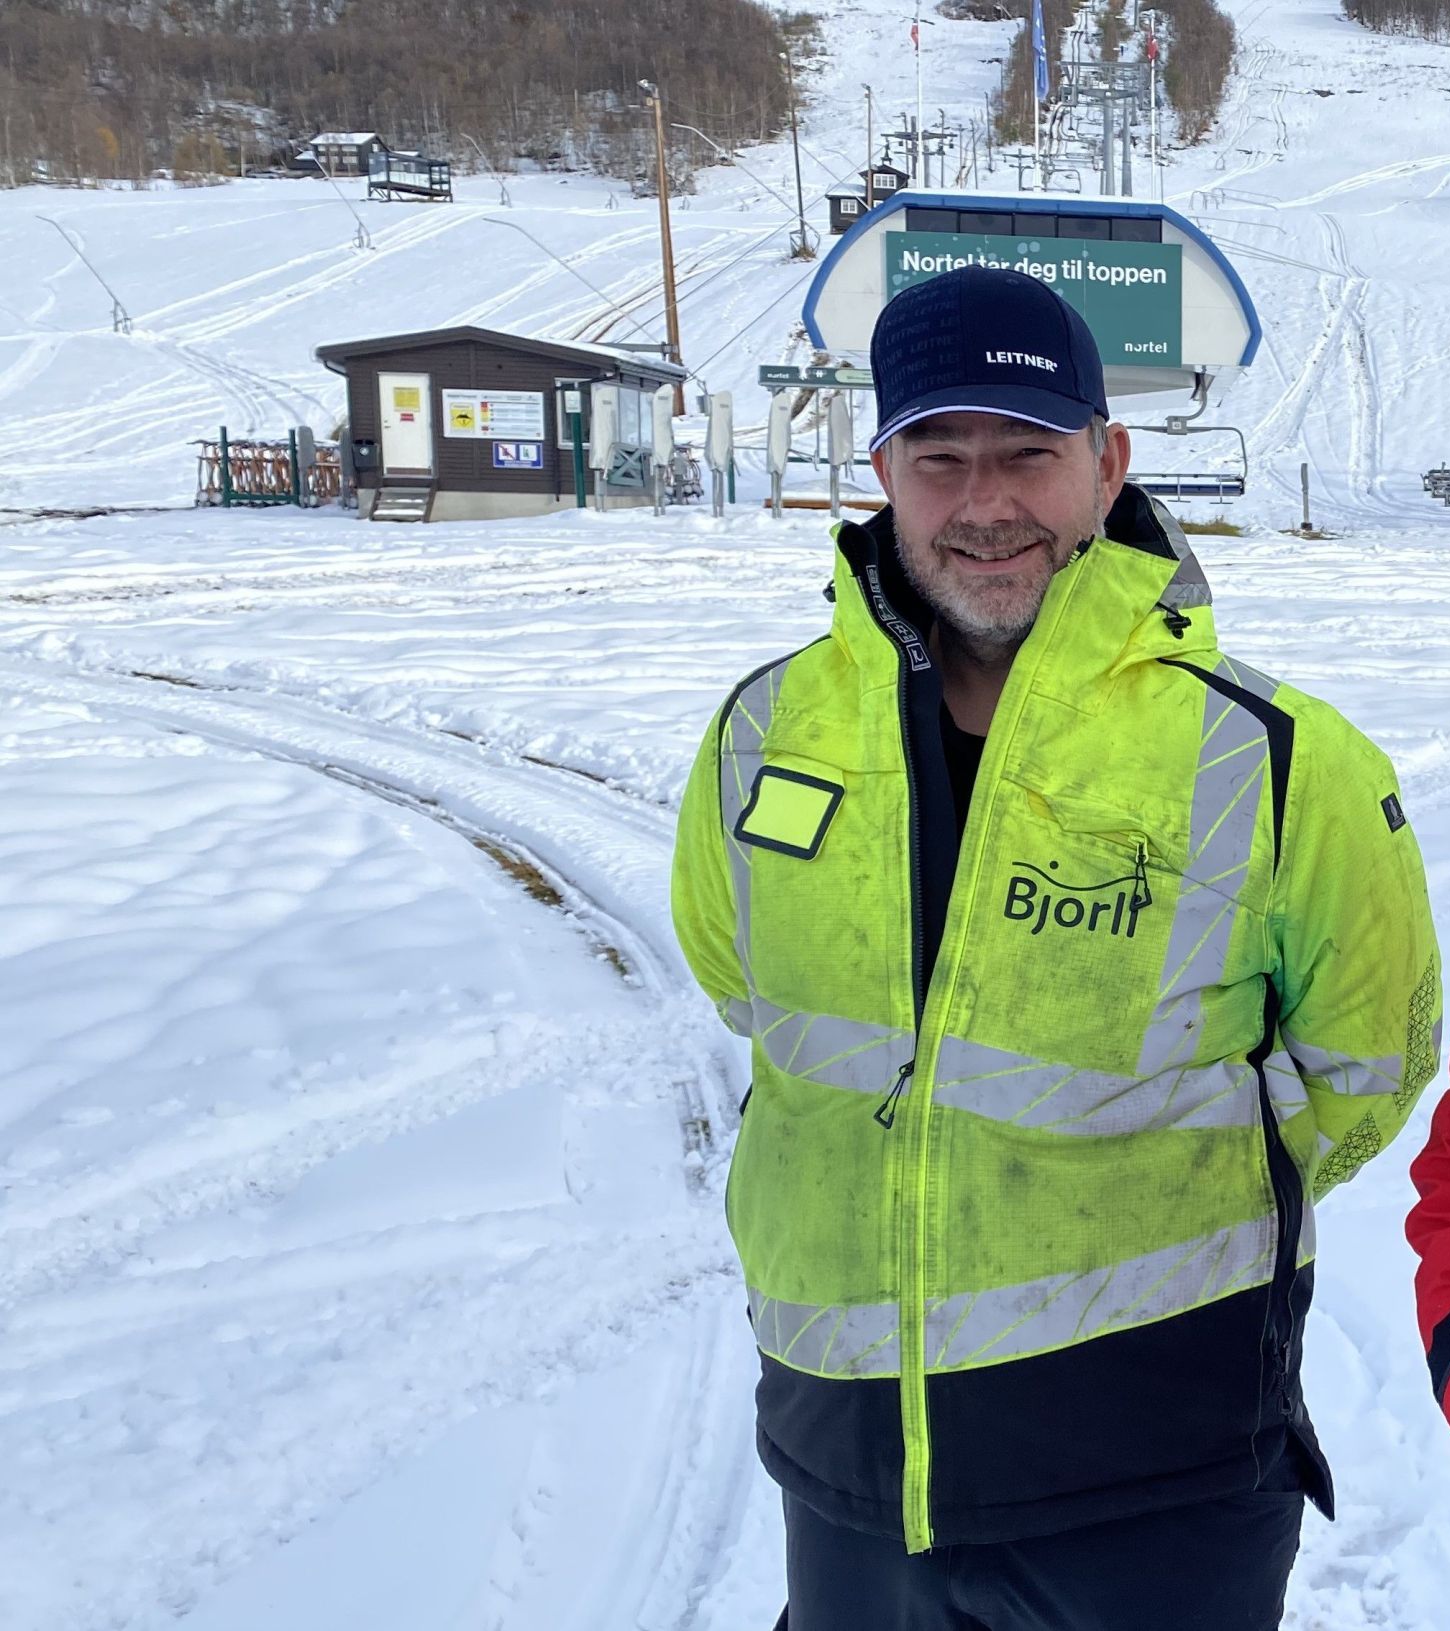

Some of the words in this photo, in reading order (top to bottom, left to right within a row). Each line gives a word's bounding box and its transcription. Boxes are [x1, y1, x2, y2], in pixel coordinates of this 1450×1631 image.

[902, 250, 974, 274] Nortel
[1013, 257, 1057, 283] deg
[1061, 259, 1082, 280] til
[1087, 261, 1168, 287] toppen
[985, 351, 1058, 373] LEITNER
[1124, 341, 1168, 354] nortel
[1003, 876, 1143, 938] Bjorli
